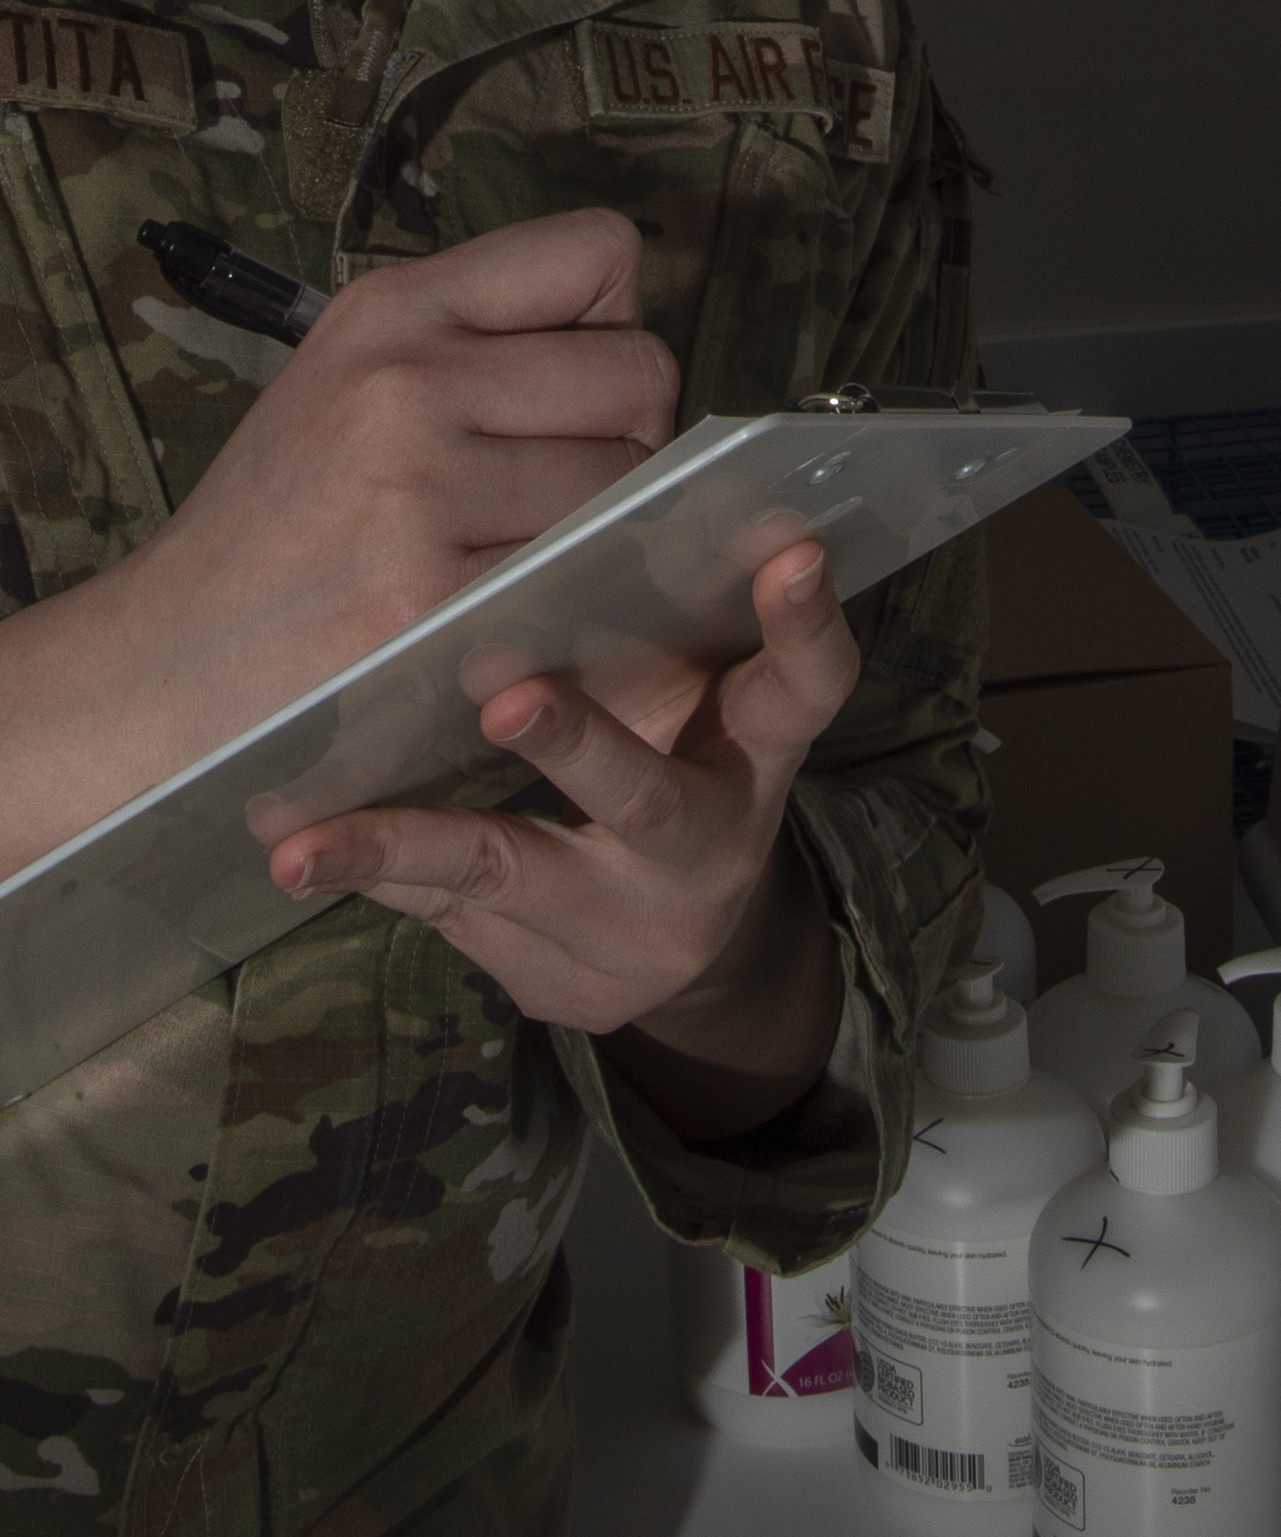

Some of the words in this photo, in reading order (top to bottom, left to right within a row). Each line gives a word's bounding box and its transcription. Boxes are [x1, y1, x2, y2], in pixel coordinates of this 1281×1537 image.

[605, 34, 692, 107] U.S.
[709, 34, 795, 102] AIR
[798, 1375, 812, 1389] 16
[814, 1373, 826, 1387] FL
[828, 1370, 845, 1385] OZ
[1171, 1496, 1197, 1505] 4235
